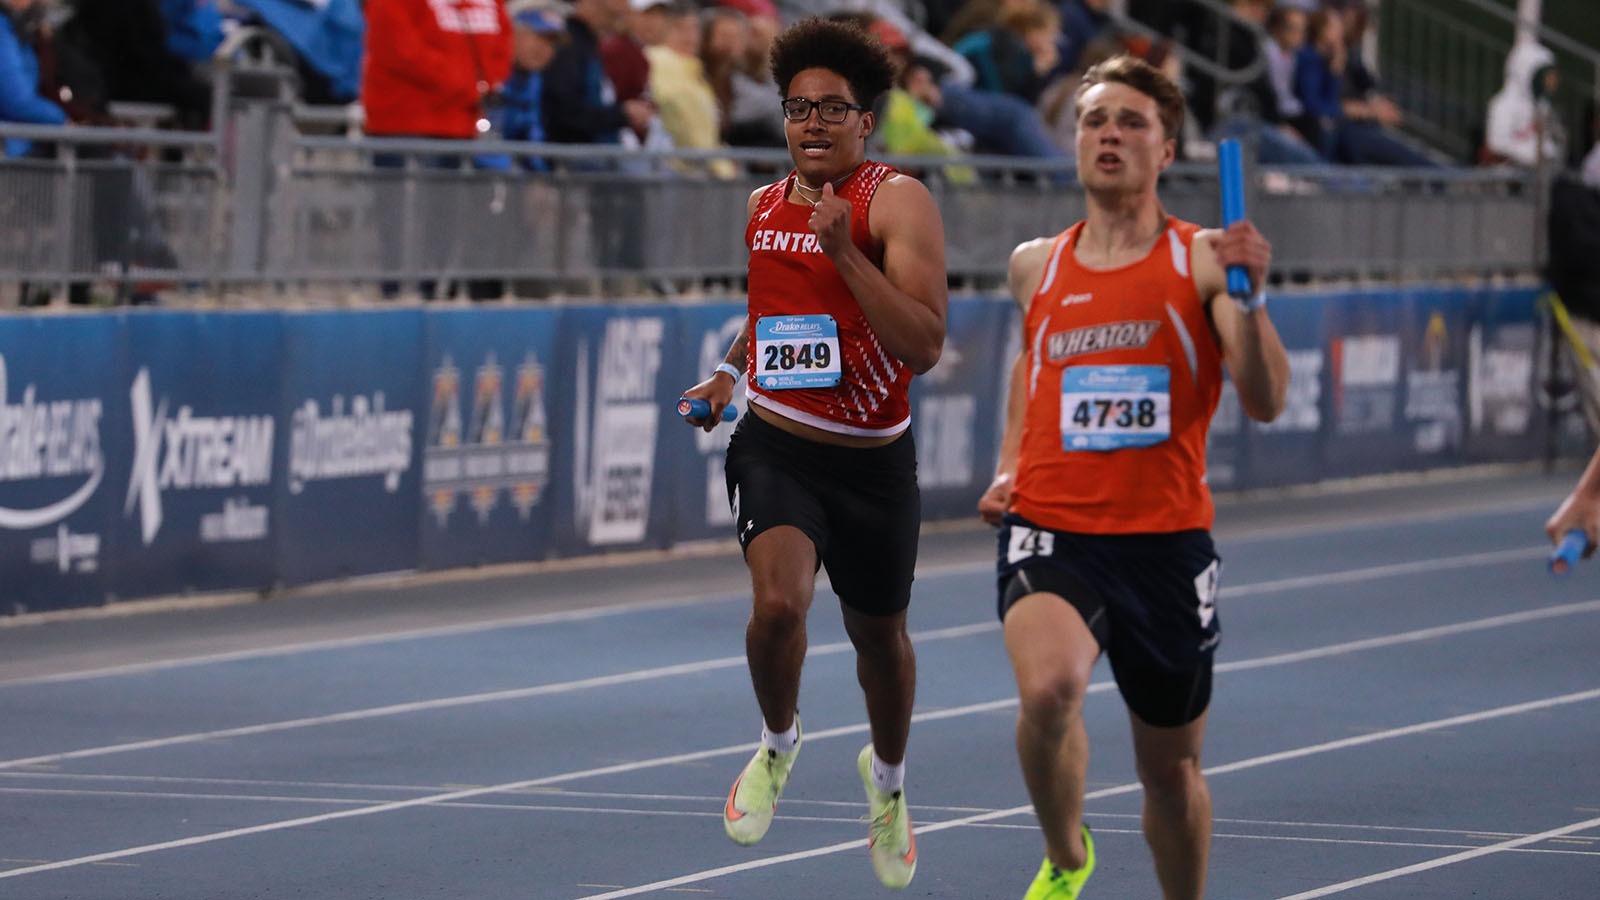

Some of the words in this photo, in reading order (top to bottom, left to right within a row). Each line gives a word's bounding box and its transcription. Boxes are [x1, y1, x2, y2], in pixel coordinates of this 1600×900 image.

[752, 229, 824, 253] CENTRA
[775, 320, 800, 332] Drake
[1048, 321, 1156, 359] WHEATON
[764, 342, 831, 371] 2849
[1072, 399, 1156, 428] 4738
[1019, 530, 1045, 556] 4
